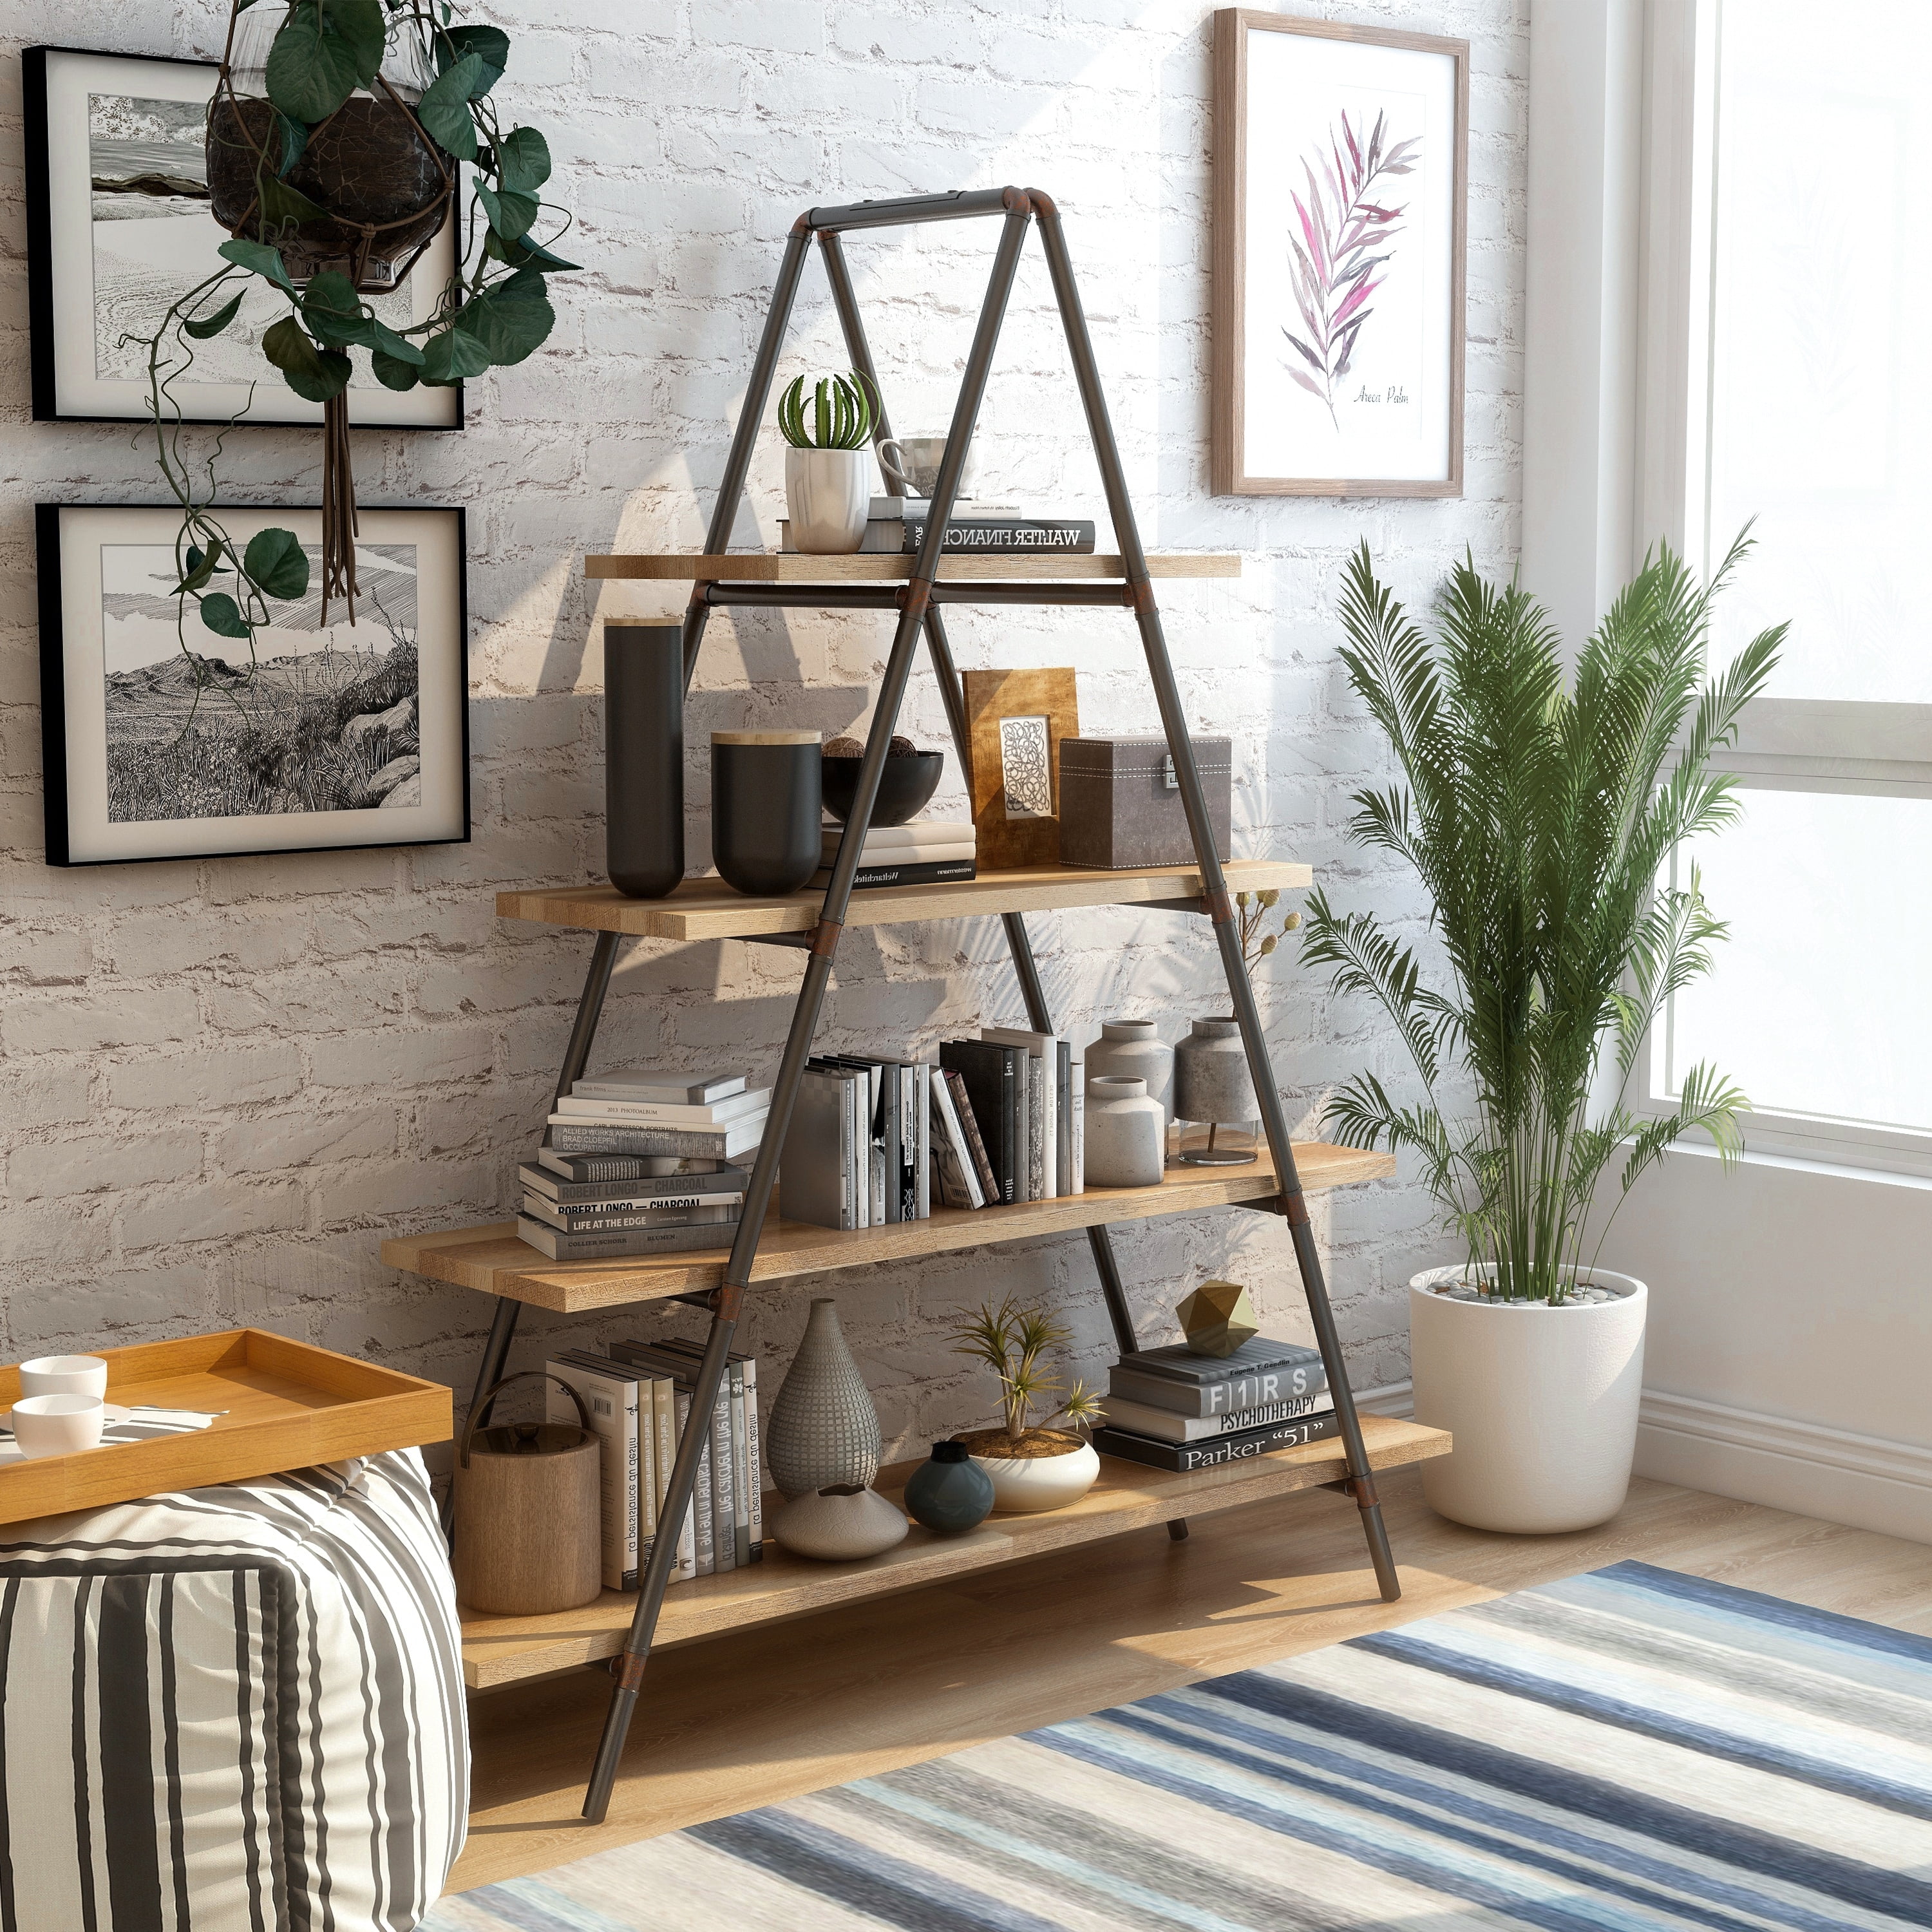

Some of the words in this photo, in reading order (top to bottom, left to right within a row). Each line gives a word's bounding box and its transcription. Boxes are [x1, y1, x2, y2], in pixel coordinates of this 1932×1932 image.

[1354, 385, 1381, 402] Areca
[1387, 386, 1408, 404] Palm
[583, 1137, 617, 1145] CLOEPFIL
[614, 1130, 669, 1139] ARCHITECTURE
[563, 1144, 609, 1152] OCCUPATION
[562, 1184, 603, 1199] ROBERT
[605, 1182, 638, 1196] LONGO
[654, 1177, 708, 1193] CHARCOAL
[573, 1221, 591, 1231] LIFE
[592, 1220, 603, 1229] AT
[604, 1218, 622, 1228] THE
[623, 1217, 647, 1226] EDGE
[1229, 1367, 1255, 1376] Eugene
[1264, 1359, 1290, 1369] Gendlin
[680, 1401, 688, 1410] 101
[1220, 1396, 1316, 1432] PSYCHOTHERAPY
[1185, 1441, 1266, 1470] Parker
[697, 1463, 711, 1498] catcher
[699, 1501, 712, 1511] in
[699, 1511, 712, 1528] the
[696, 1529, 712, 1546] rye
